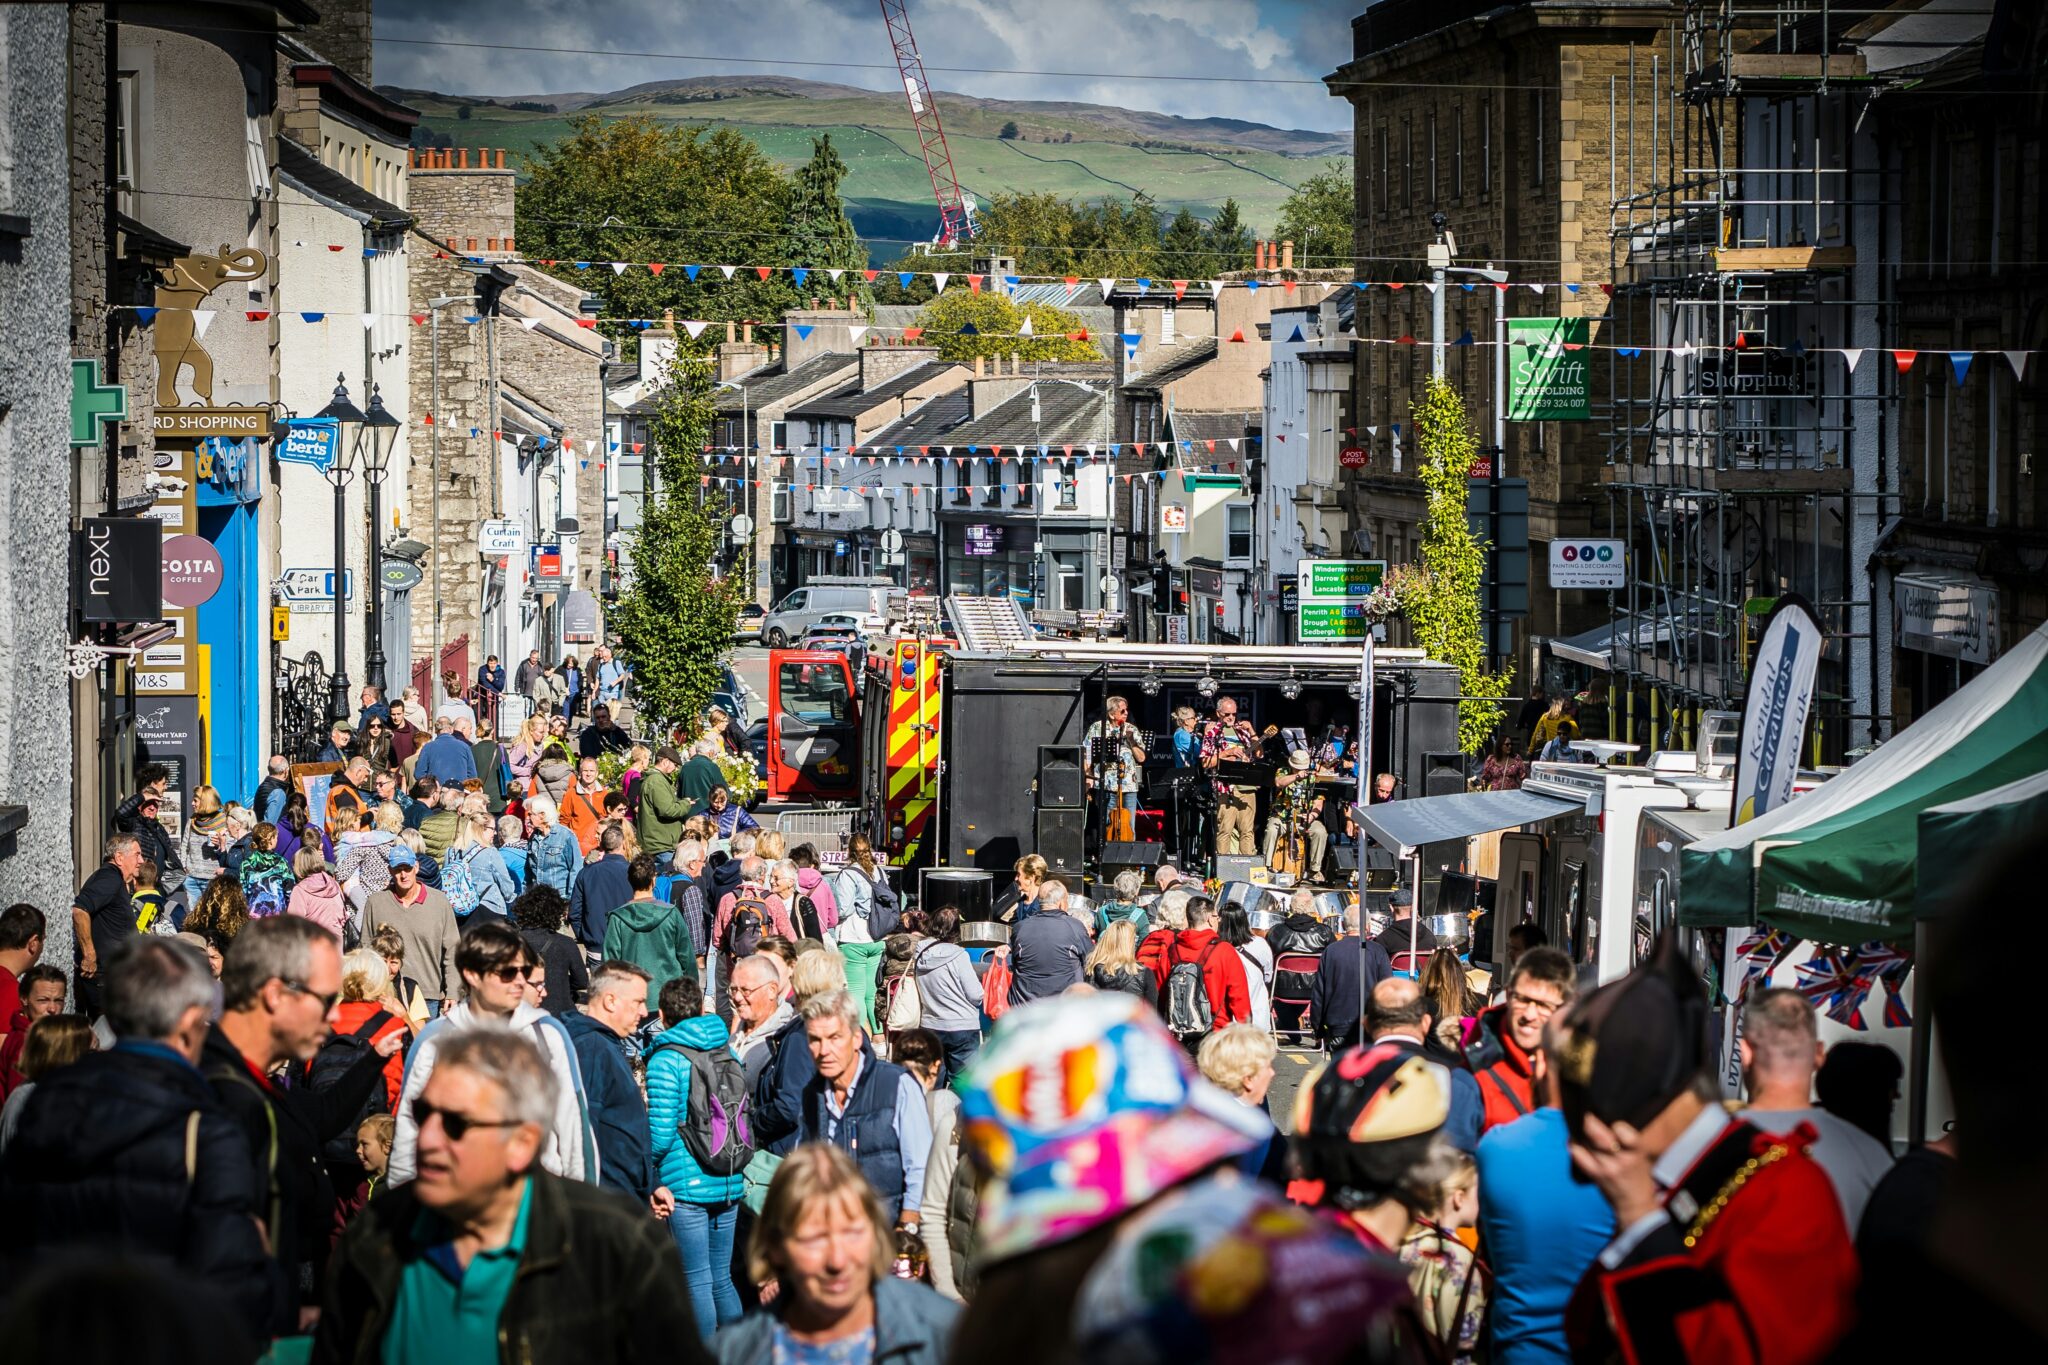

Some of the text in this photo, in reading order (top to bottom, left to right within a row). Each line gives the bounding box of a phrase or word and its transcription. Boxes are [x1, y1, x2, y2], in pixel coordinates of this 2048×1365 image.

[1516, 361, 1585, 384] Swift
[1702, 371, 1800, 392] Shopping
[1515, 387, 1584, 395] SCAFFOLDING
[1554, 399, 1568, 408] 324
[1571, 399, 1585, 408] 007
[180, 416, 257, 429] SHOPPING
[286, 439, 327, 455] berts
[487, 527, 520, 537] Curtain
[492, 538, 515, 548] Craft
[88, 525, 110, 595] next
[162, 559, 215, 574] COSTA
[300, 573, 318, 583] Car
[298, 586, 320, 594] Park
[1303, 619, 1356, 627] Brough (A685)
[135, 674, 168, 687] M&S
[1749, 660, 1778, 764] Kendal
[1757, 656, 1793, 792] Caravans
